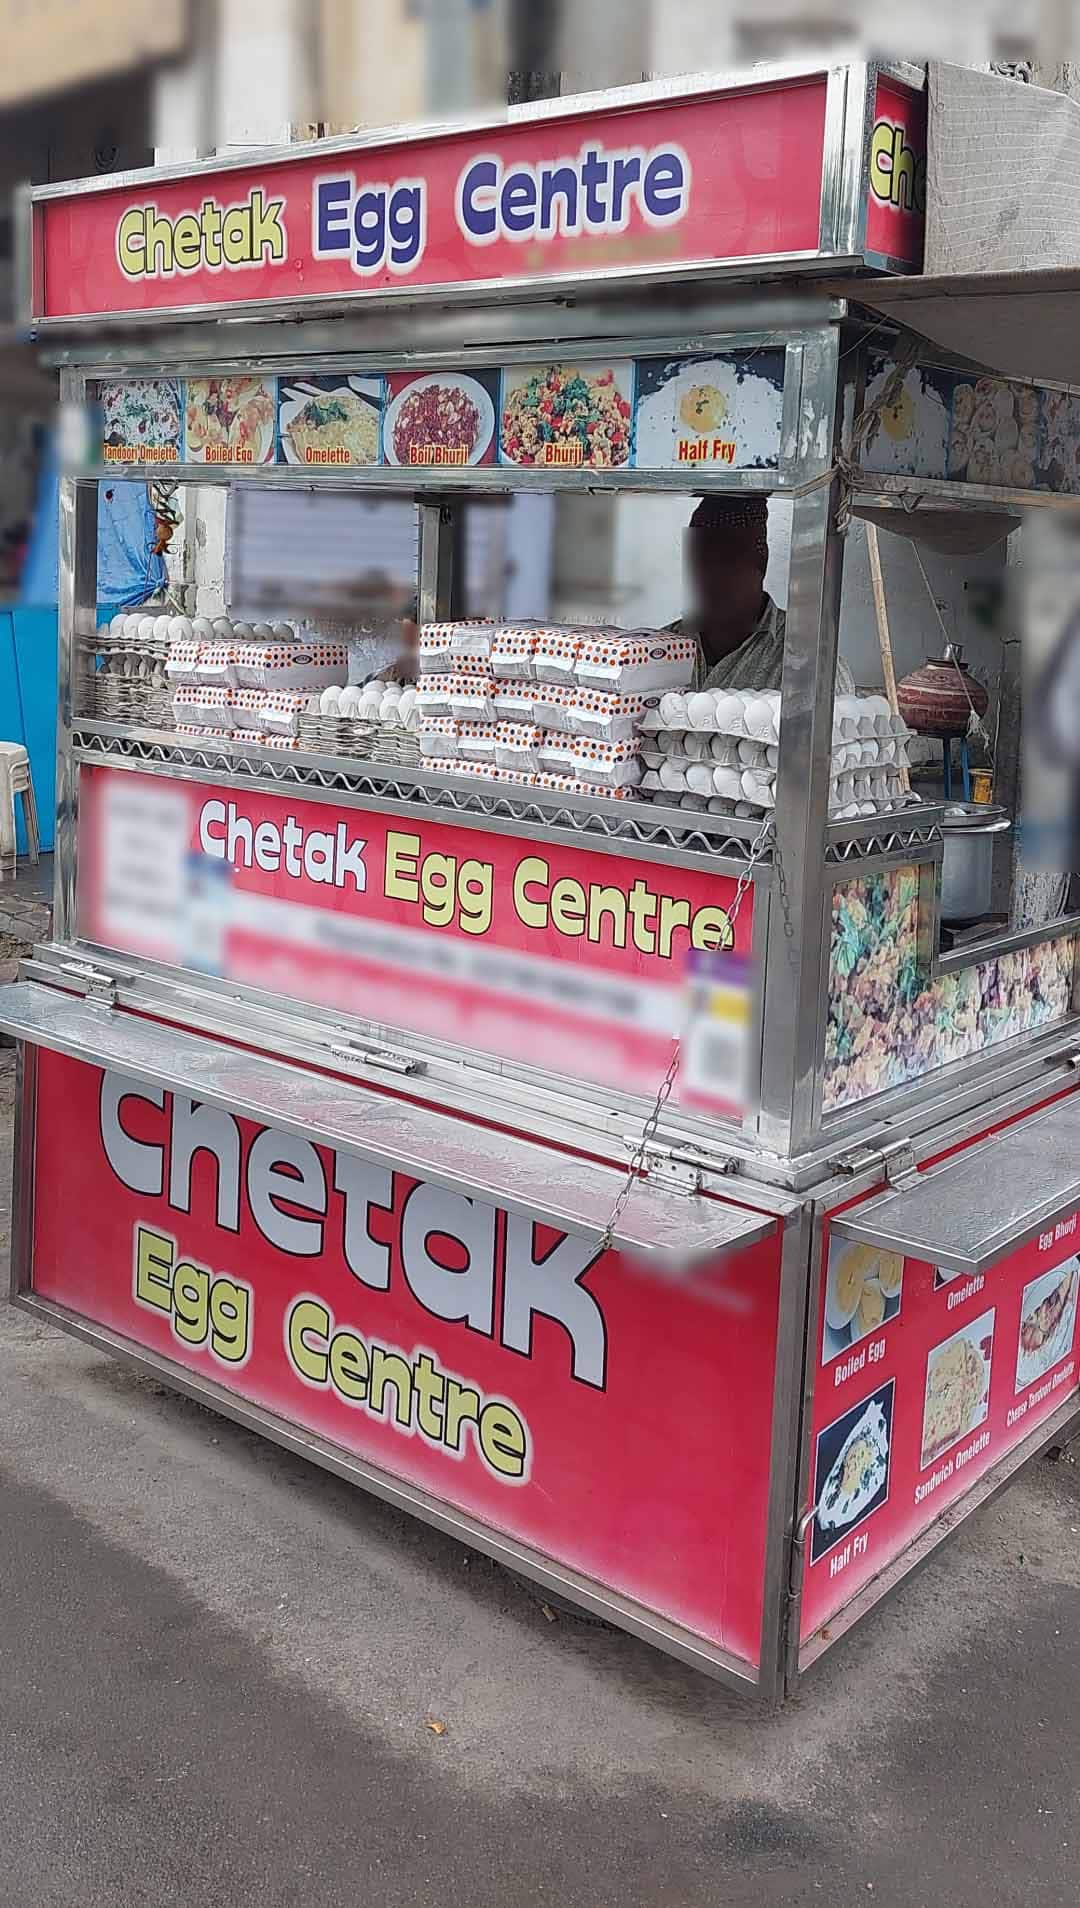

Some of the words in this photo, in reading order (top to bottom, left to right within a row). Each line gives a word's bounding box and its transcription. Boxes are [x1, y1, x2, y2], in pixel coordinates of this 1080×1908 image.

[118, 191, 285, 275] Chetak
[317, 179, 421, 268] Egg
[461, 150, 683, 236] Centre
[140, 445, 177, 462] Omelette
[205, 445, 233, 462] Boiled
[235, 446, 252, 463] Egg
[305, 445, 350, 464] Omelette
[409, 446, 431, 464] Boil
[544, 443, 583, 465] Bhurji
[678, 439, 708, 461] Half
[712, 438, 736, 464] Fry
[199, 799, 367, 893] Chetak
[384, 830, 494, 936] Egg
[513, 856, 735, 960] Centre
[100, 1068, 608, 1392] Chetak
[1038, 1231, 1054, 1252] Egg
[1054, 1212, 1078, 1242] Bhurji
[946, 1273, 985, 1311] Omelette
[136, 1226, 250, 1364] Egg
[289, 1299, 527, 1478] Centre
[834, 1347, 866, 1387] Boiled
[868, 1337, 886, 1363] Egg
[914, 1459, 954, 1505] Sandwich
[955, 1430, 990, 1471] Omelette
[829, 1543, 851, 1579] Half
[853, 1531, 869, 1558] Fry
